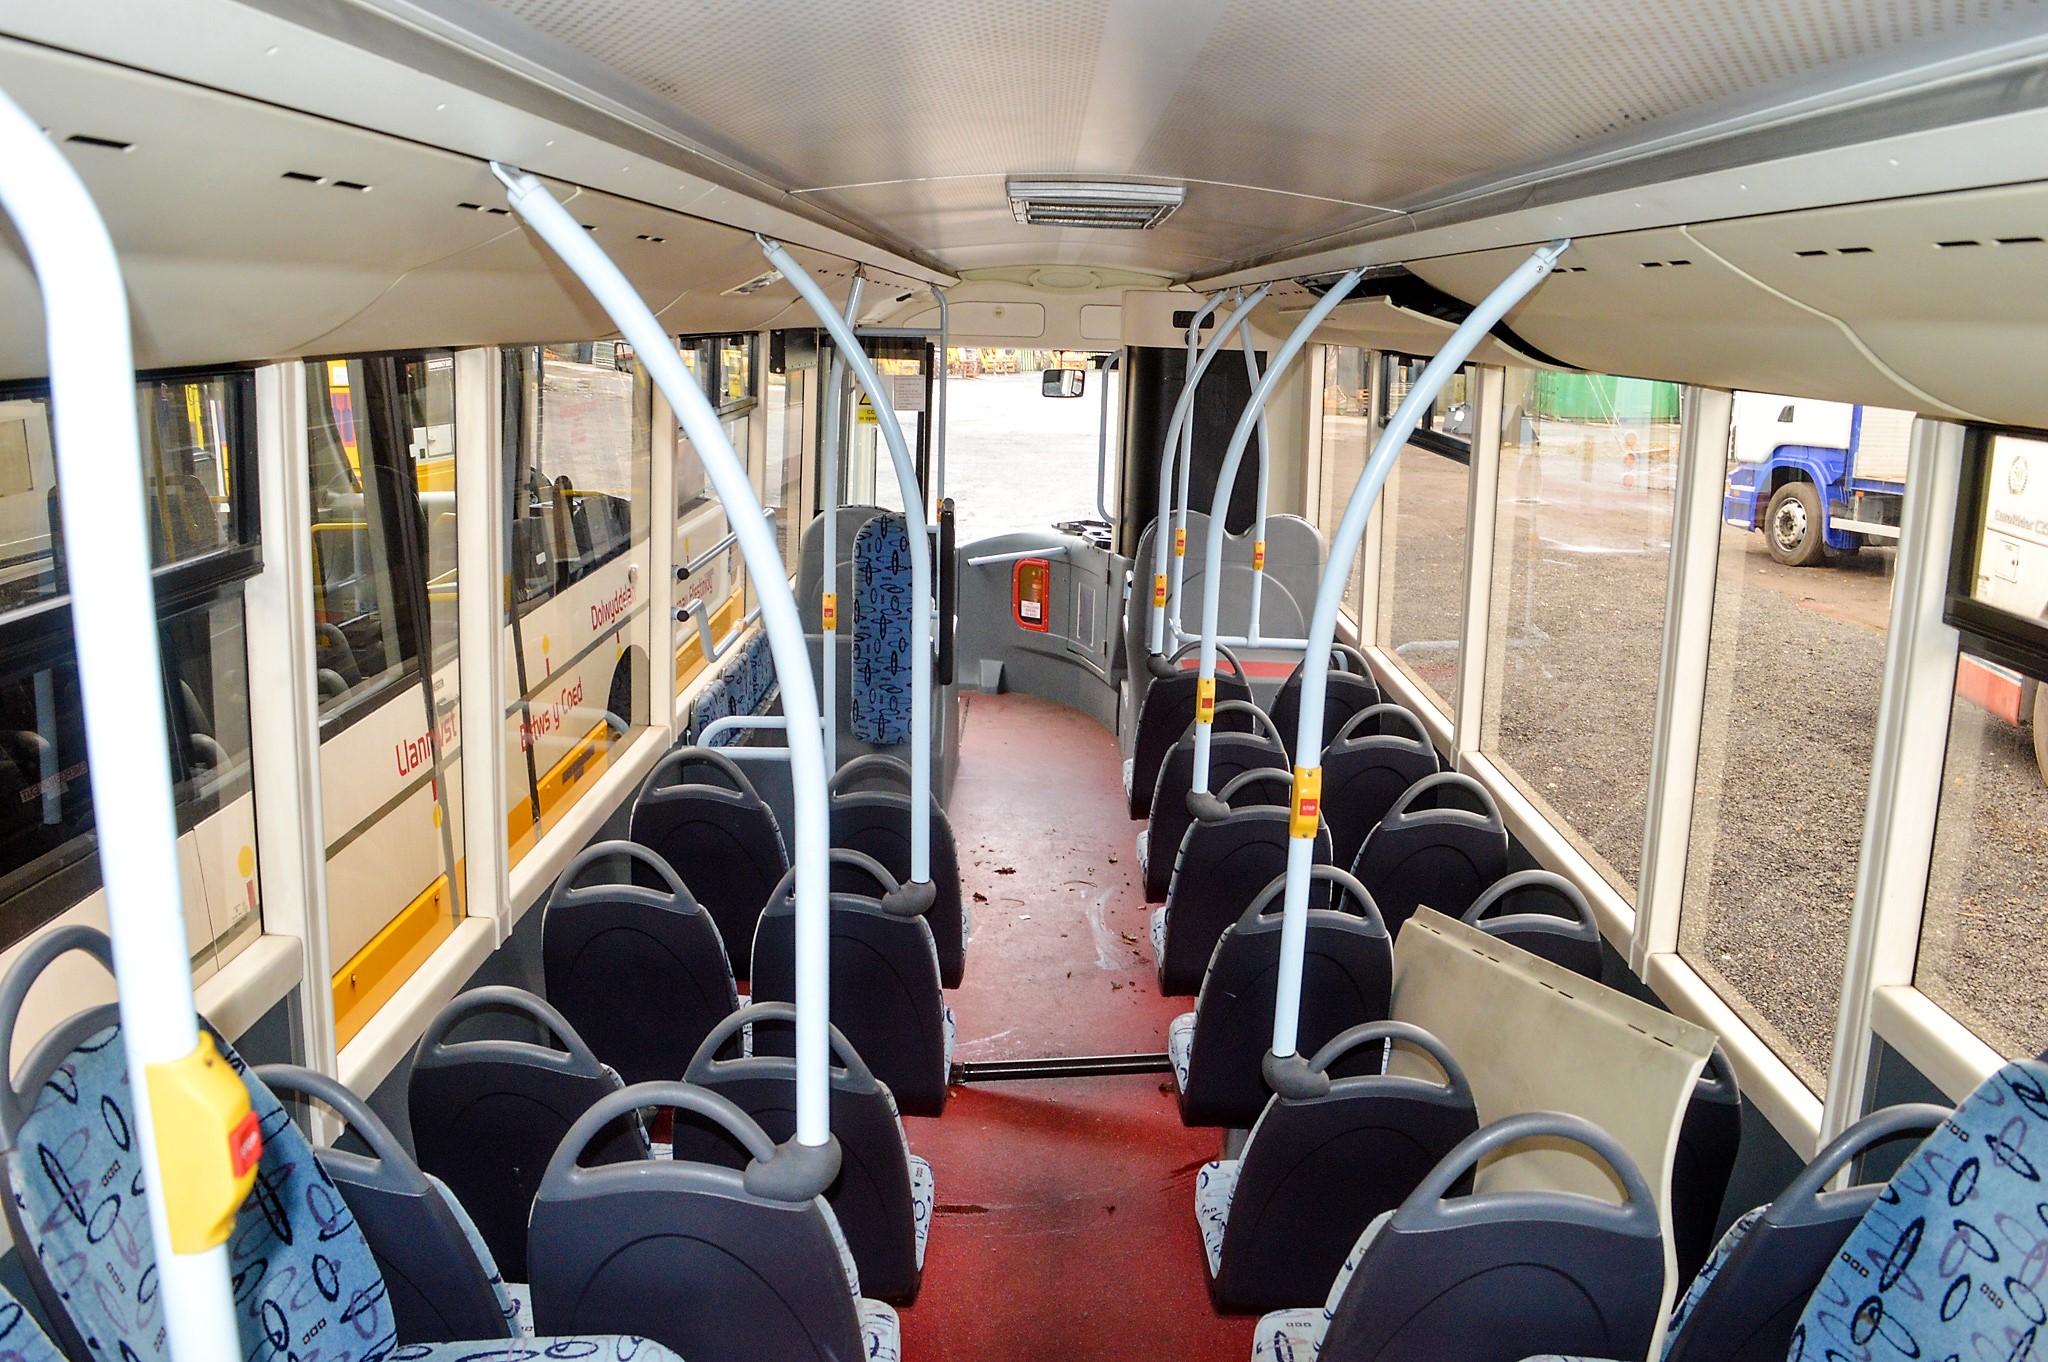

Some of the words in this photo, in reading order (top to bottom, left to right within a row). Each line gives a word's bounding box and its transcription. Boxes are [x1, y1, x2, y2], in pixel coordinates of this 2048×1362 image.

[519, 709, 551, 752] Betws
[553, 702, 560, 731] y
[561, 676, 583, 715] Coed
[240, 1131, 260, 1157] STOP
